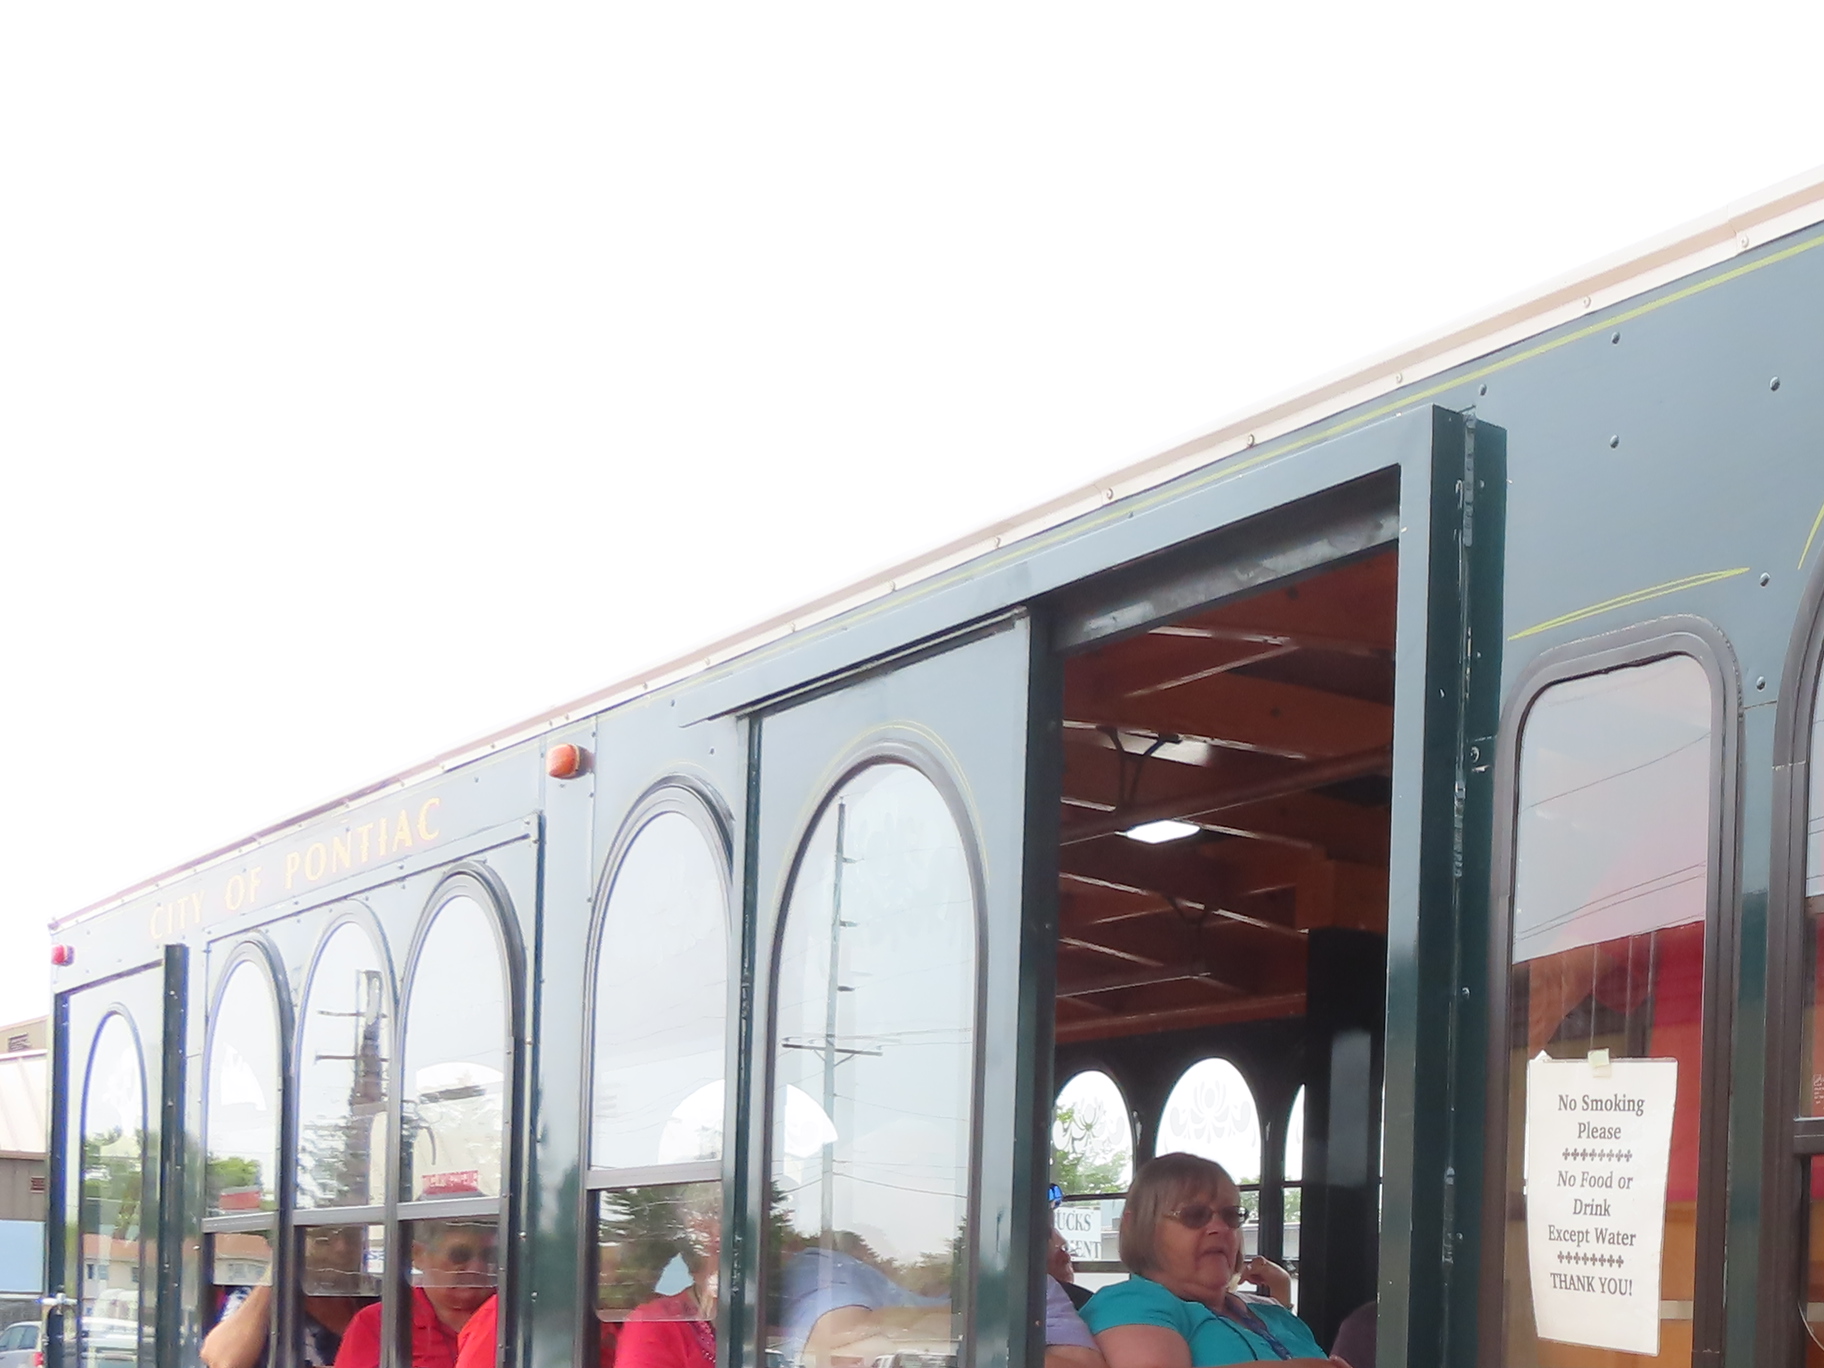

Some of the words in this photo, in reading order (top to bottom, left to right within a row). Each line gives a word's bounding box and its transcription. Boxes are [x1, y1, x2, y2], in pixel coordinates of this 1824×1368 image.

[150, 889, 207, 940] CITY
[224, 866, 263, 912] OF
[284, 798, 441, 890] PONTIAC
[1557, 1093, 1577, 1112] No
[1582, 1093, 1645, 1117] Smoking
[1577, 1121, 1622, 1140] Please
[1556, 1170, 1576, 1188] No
[1580, 1171, 1613, 1189] Food
[1617, 1177, 1634, 1190] or
[1572, 1198, 1611, 1218] Drink
[1057, 1211, 1091, 1232] UCKS
[1547, 1224, 1590, 1247] Except
[1594, 1227, 1637, 1247] Water
[1549, 1272, 1595, 1293] THANK
[1598, 1276, 1633, 1297] YOU!
